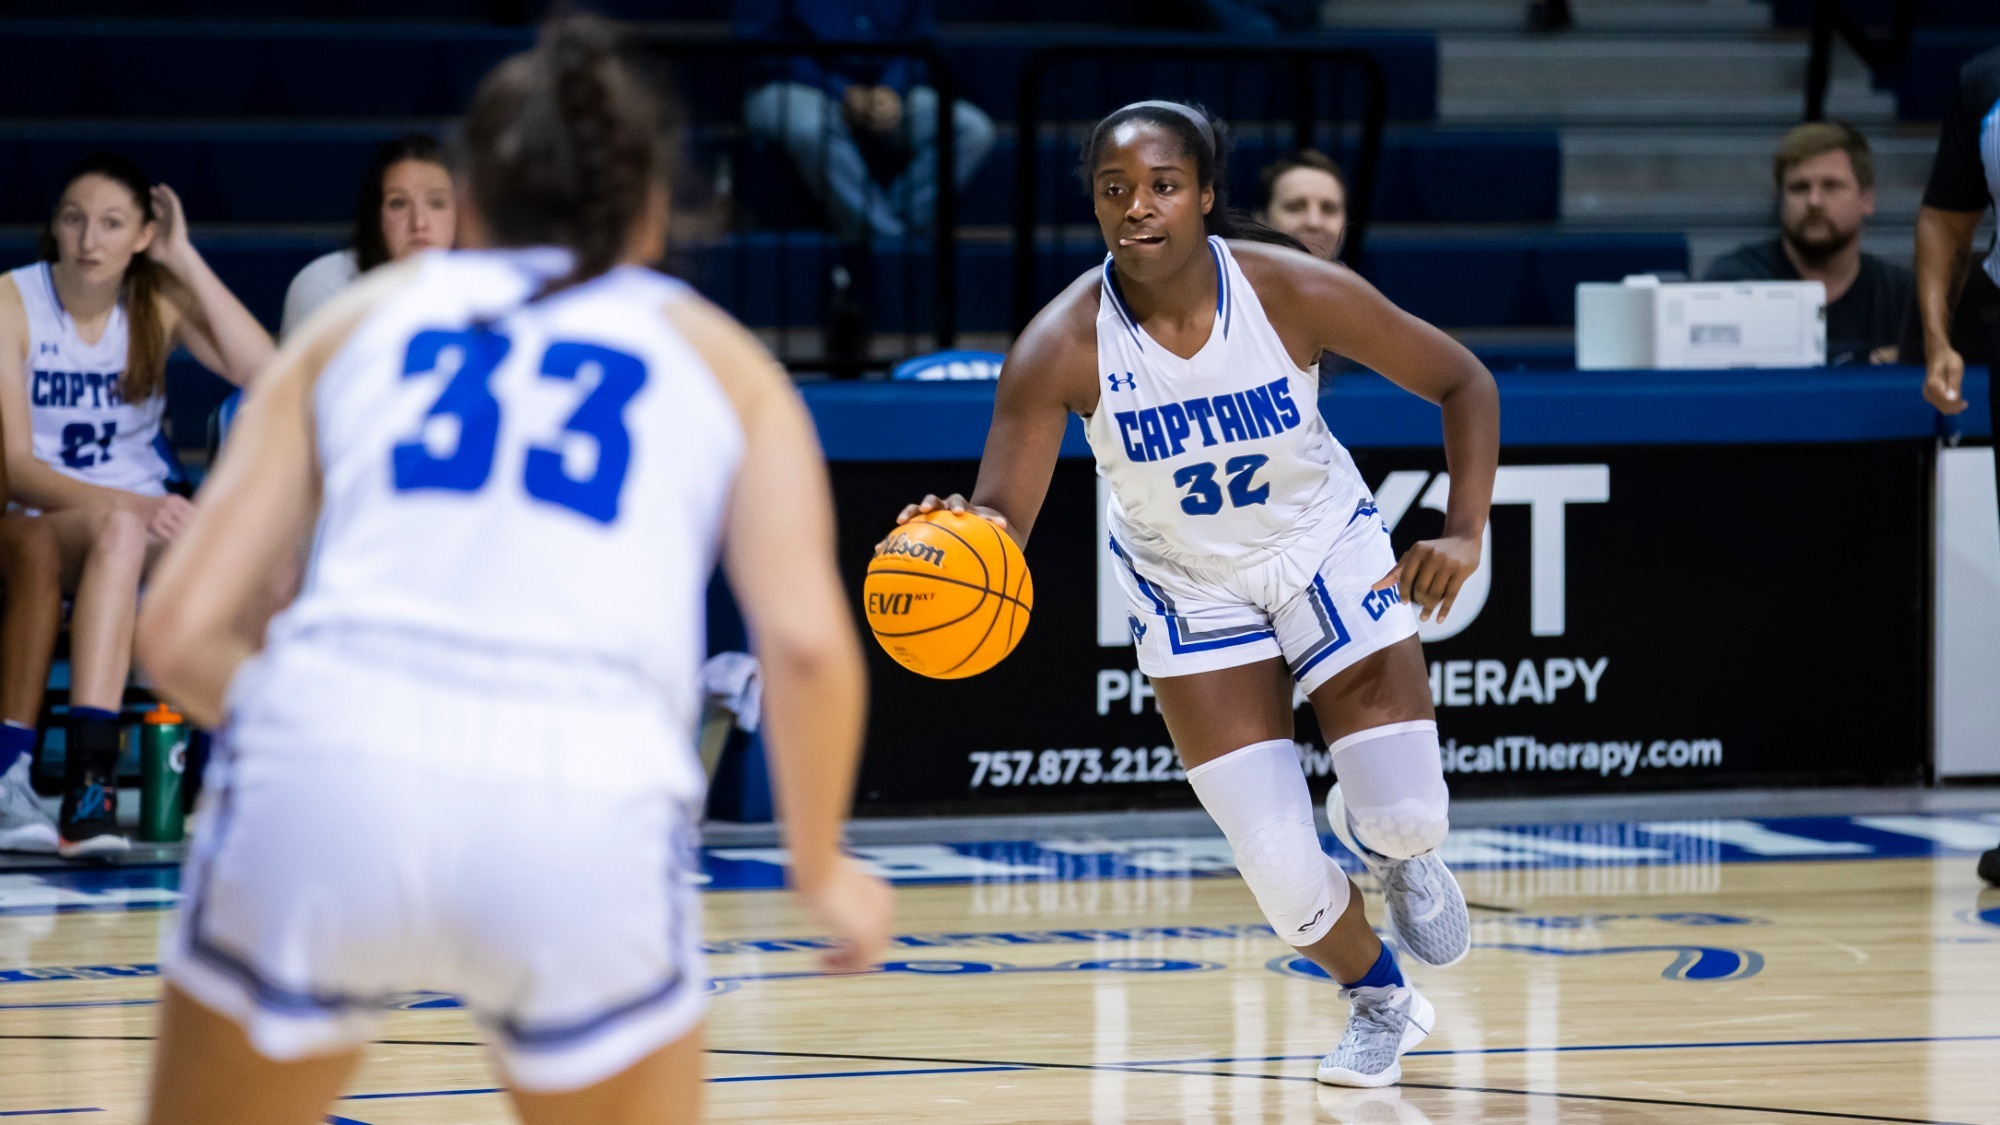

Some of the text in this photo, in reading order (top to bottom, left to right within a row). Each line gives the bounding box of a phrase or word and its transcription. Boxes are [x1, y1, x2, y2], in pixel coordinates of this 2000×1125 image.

[31, 370, 122, 408] CAPTA
[392, 327, 650, 526] 33
[1113, 376, 1302, 463] CAPTAINS
[60, 421, 117, 470] 21
[1172, 453, 1271, 516] 32
[874, 532, 945, 568] ilson
[868, 592, 936, 616] EVO NXT
[1429, 655, 1610, 707] ERAPY
